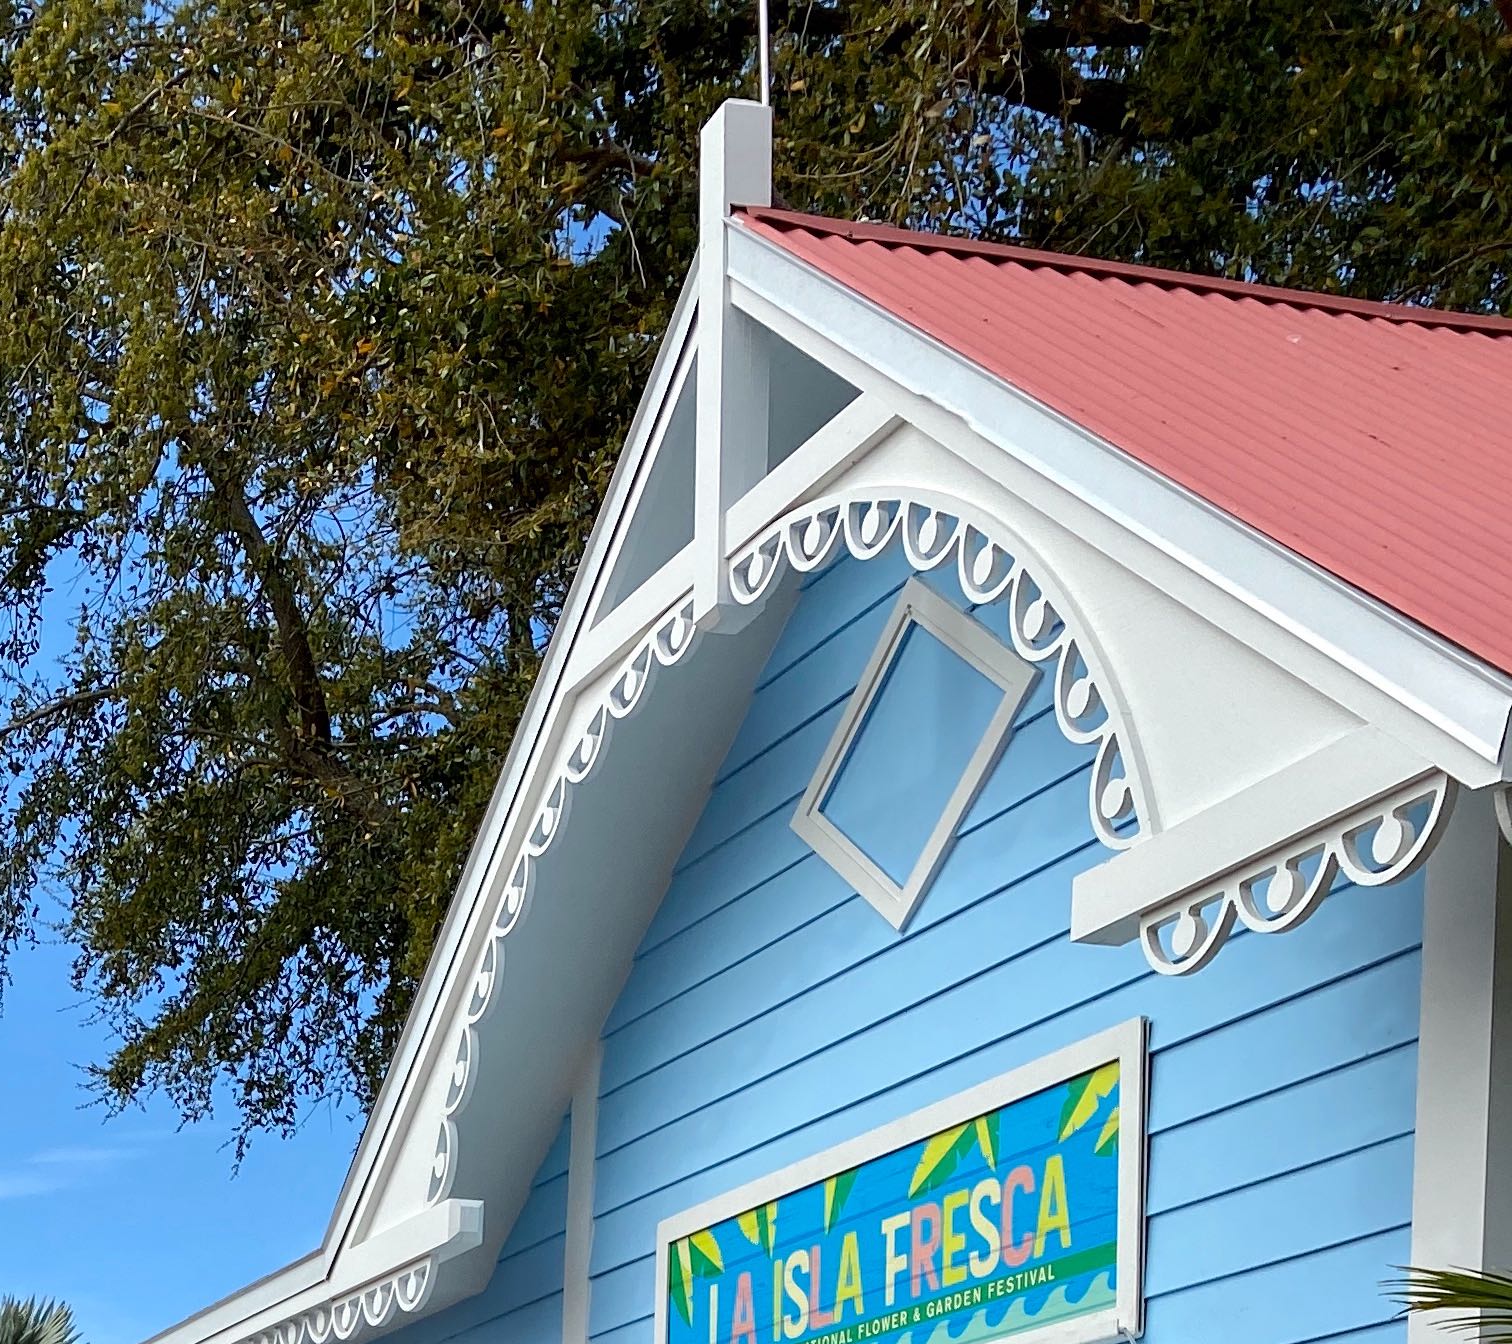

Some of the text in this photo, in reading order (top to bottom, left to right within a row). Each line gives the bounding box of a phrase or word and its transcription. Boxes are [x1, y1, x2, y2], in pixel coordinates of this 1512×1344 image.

[773, 1231, 864, 1341] ISLA
[881, 1155, 1071, 1306] FRESCA
[858, 1311, 907, 1339] FLOWER
[913, 1308, 920, 1321] &
[926, 1288, 981, 1317] GARDEN
[988, 1266, 1055, 1298] FESTIVAL
